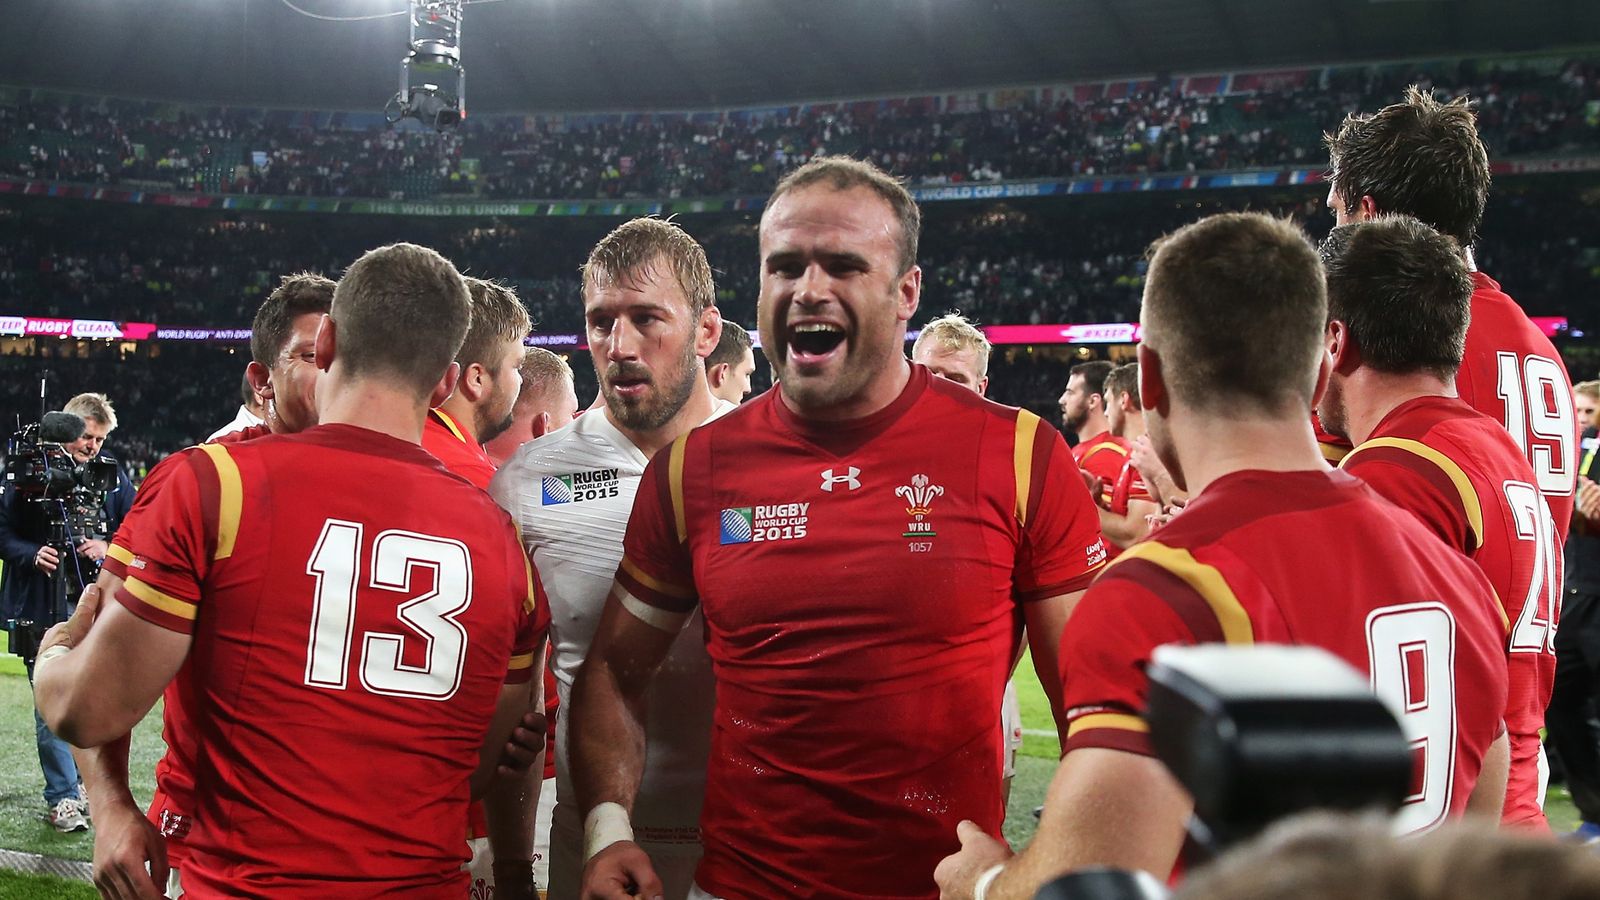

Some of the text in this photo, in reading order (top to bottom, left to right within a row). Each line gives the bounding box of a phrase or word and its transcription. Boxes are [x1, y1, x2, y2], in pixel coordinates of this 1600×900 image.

[921, 184, 1039, 200] WORLD CUP 2015
[368, 202, 520, 216] THE WORLD IN UNION
[0, 320, 114, 333] EEP RUGBY CLEAN
[156, 329, 185, 340] WORLD
[214, 329, 253, 339] ANTI-DOP
[1497, 351, 1575, 497] 19
[573, 468, 619, 484] RUGBY
[574, 482, 602, 491] WORLD
[573, 487, 619, 503] 2015
[754, 502, 810, 520] RUGBY
[754, 517, 808, 528] WORLD CUP
[908, 522, 931, 532] WRU
[753, 526, 807, 542] 2015
[908, 542, 933, 552] 1057
[1503, 479, 1565, 656] 20
[304, 518, 473, 701] 13
[1365, 601, 1457, 837] 9
